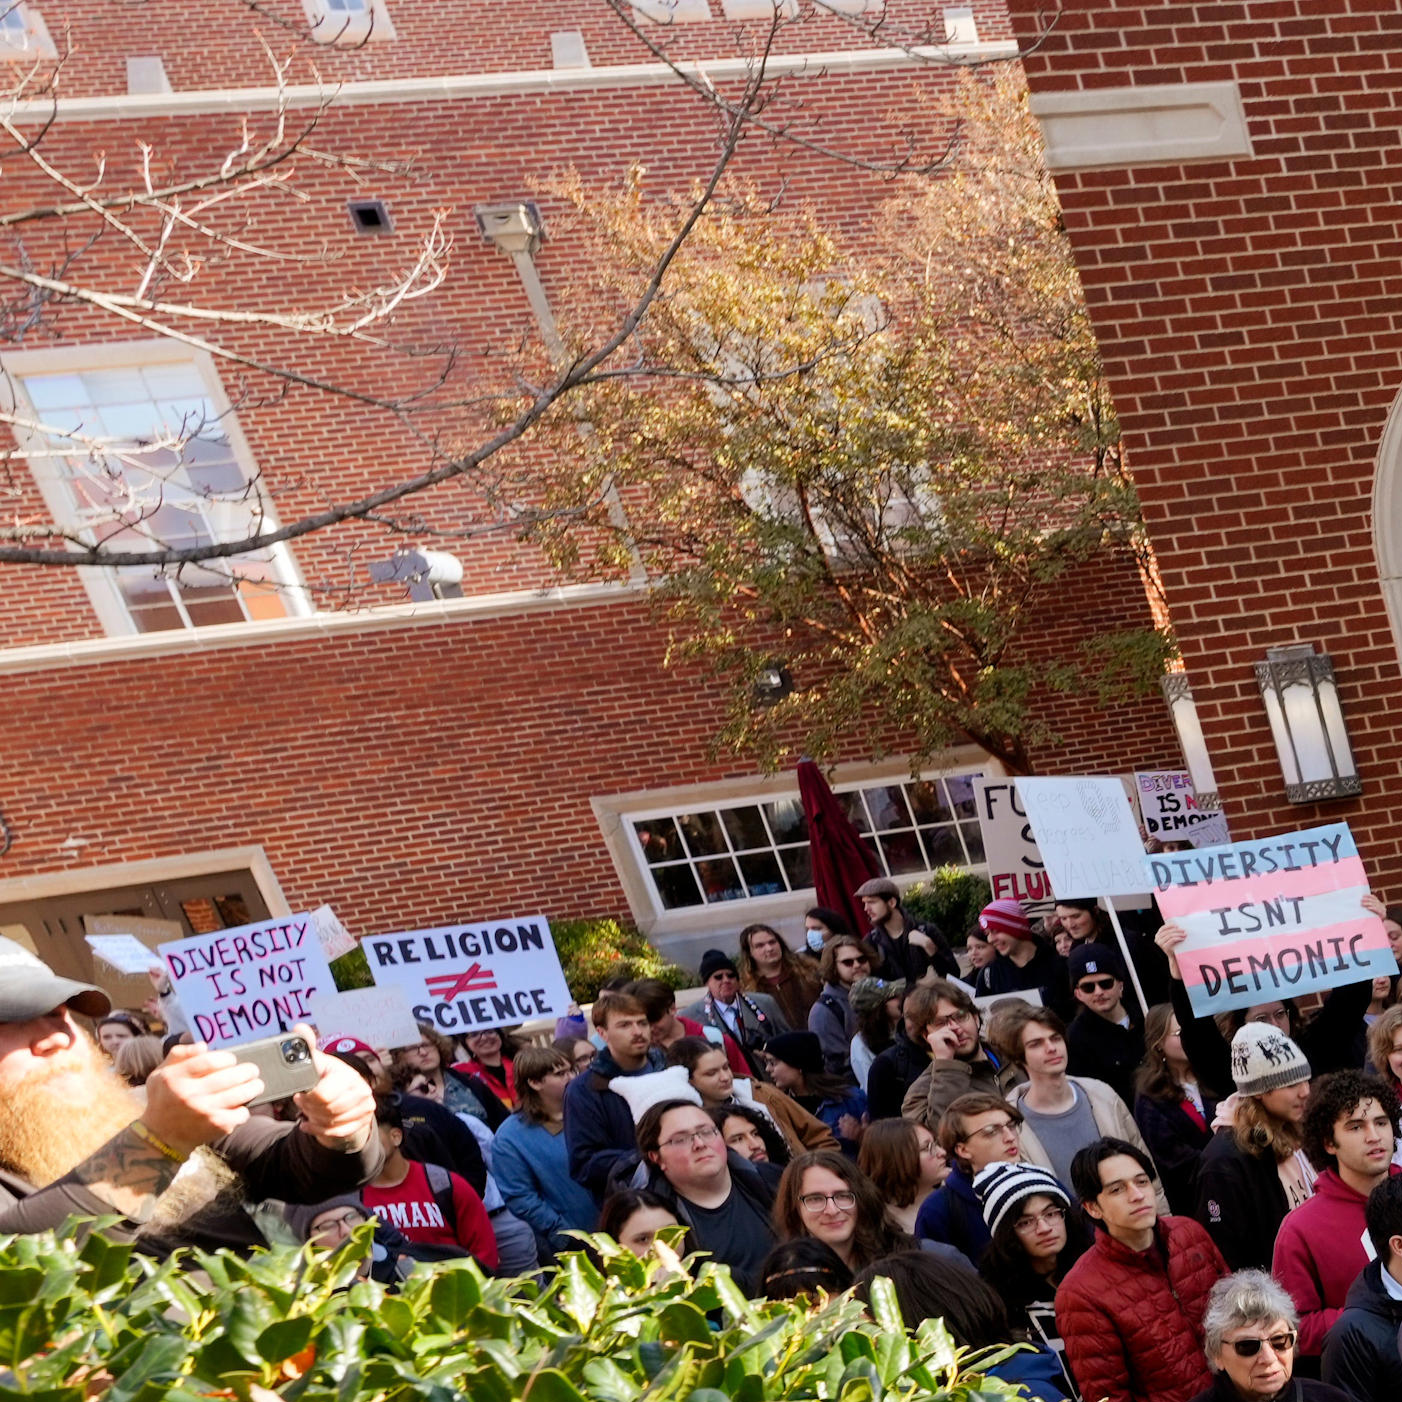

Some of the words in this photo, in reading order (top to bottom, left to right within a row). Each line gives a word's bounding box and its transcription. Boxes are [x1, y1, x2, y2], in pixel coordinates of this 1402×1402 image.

[1156, 792, 1181, 813] IS
[1151, 833, 1342, 893] DIVERSITY
[1209, 894, 1305, 937] ISN'T
[166, 921, 308, 981] DIVERSITY
[371, 923, 546, 968] RELIGION
[1198, 933, 1372, 998] DEMONIC
[206, 967, 247, 1001] IS
[258, 957, 307, 989] NOT
[411, 988, 554, 1029] SCIENCE
